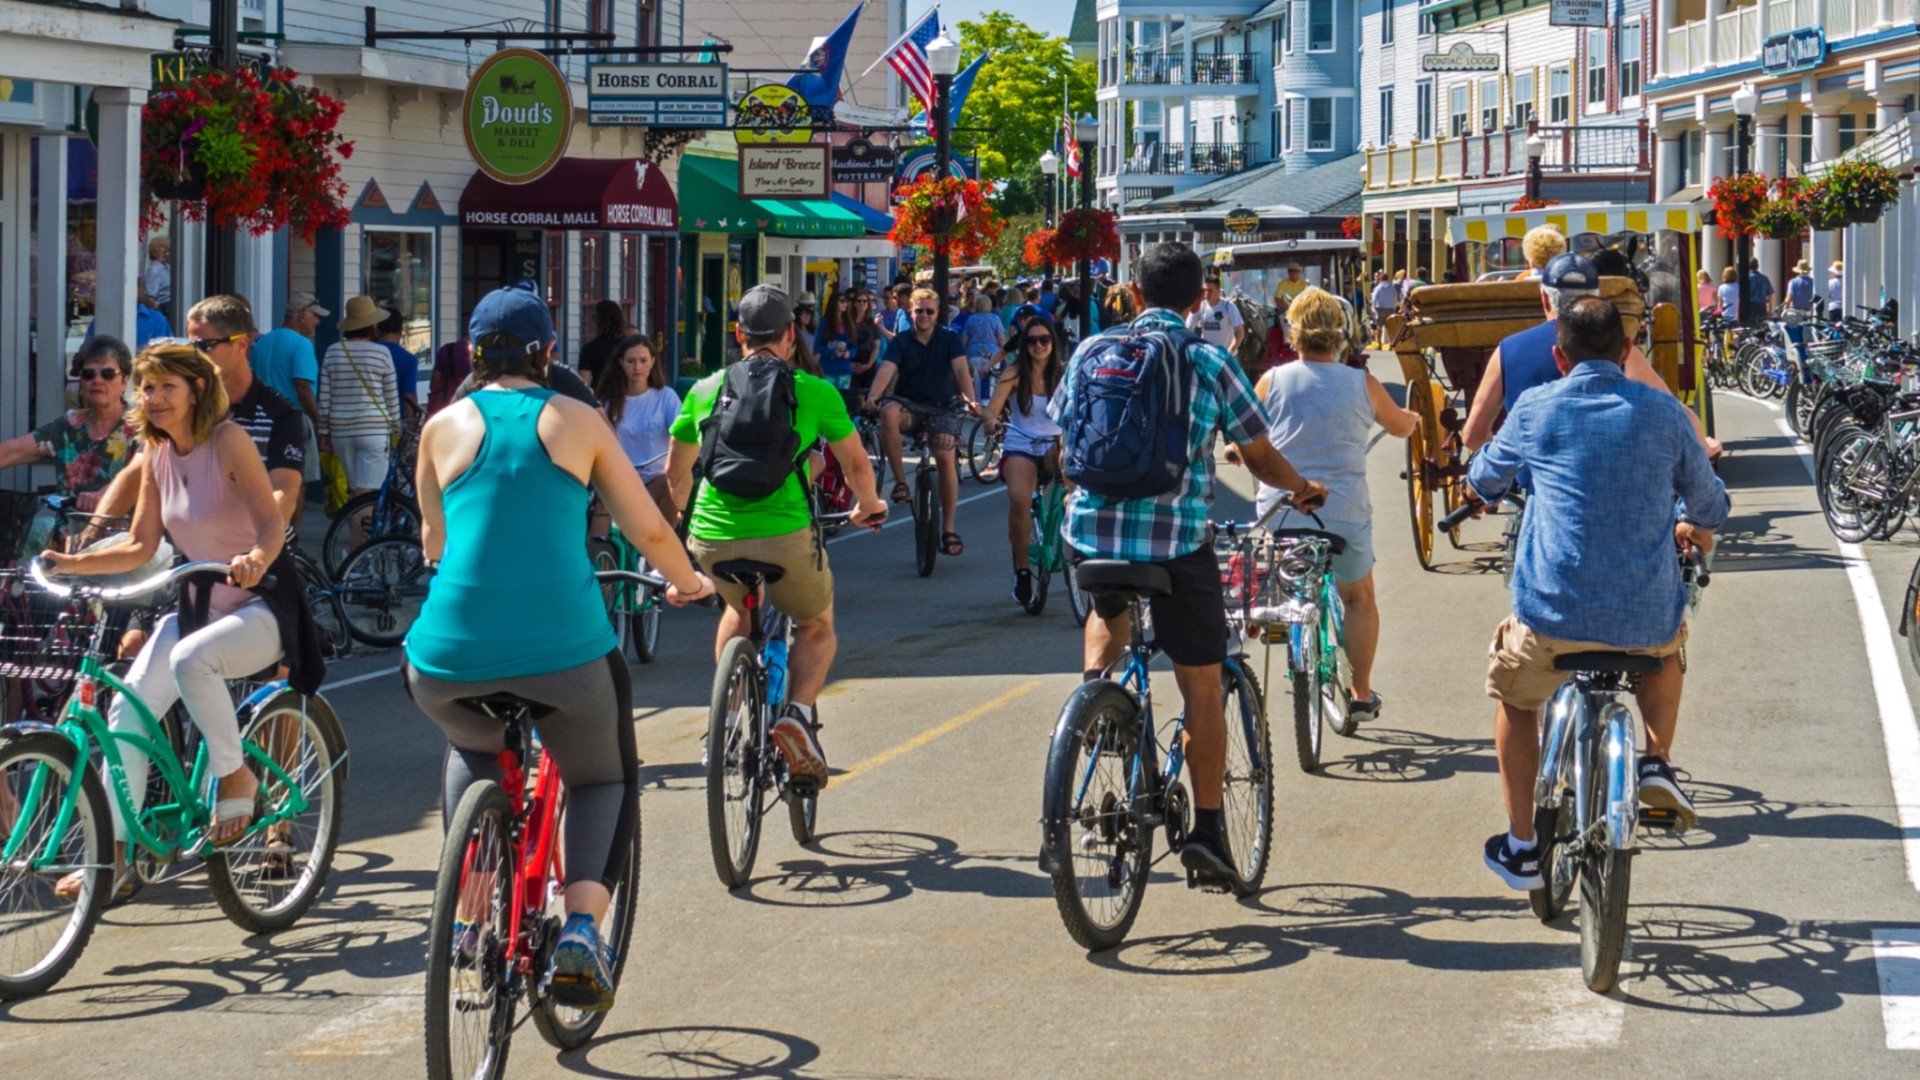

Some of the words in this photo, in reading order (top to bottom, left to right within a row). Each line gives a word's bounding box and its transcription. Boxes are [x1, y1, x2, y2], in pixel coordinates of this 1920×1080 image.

[1426, 57, 1462, 65] PONTIAC
[1466, 57, 1496, 65] LODGE
[597, 73, 650, 88] HORSE
[656, 73, 718, 88] CORRAL
[481, 95, 553, 129] Doud's
[597, 113, 620, 121] Island
[622, 113, 648, 121] Breeze
[494, 127, 541, 137] MARKET
[497, 139, 505, 147] &
[510, 139, 536, 148] DELI
[748, 158, 780, 170] Island
[782, 158, 822, 170] Breeze
[754, 177, 771, 187] Fine
[772, 177, 788, 186] Art
[789, 178, 815, 188] Gallery
[466, 211, 508, 224] HORSE
[510, 212, 560, 225] CORRAL
[563, 213, 598, 224] MALL
[607, 204, 630, 224] HORSE
[631, 205, 656, 225] CORRAL
[656, 207, 673, 227] MALL
